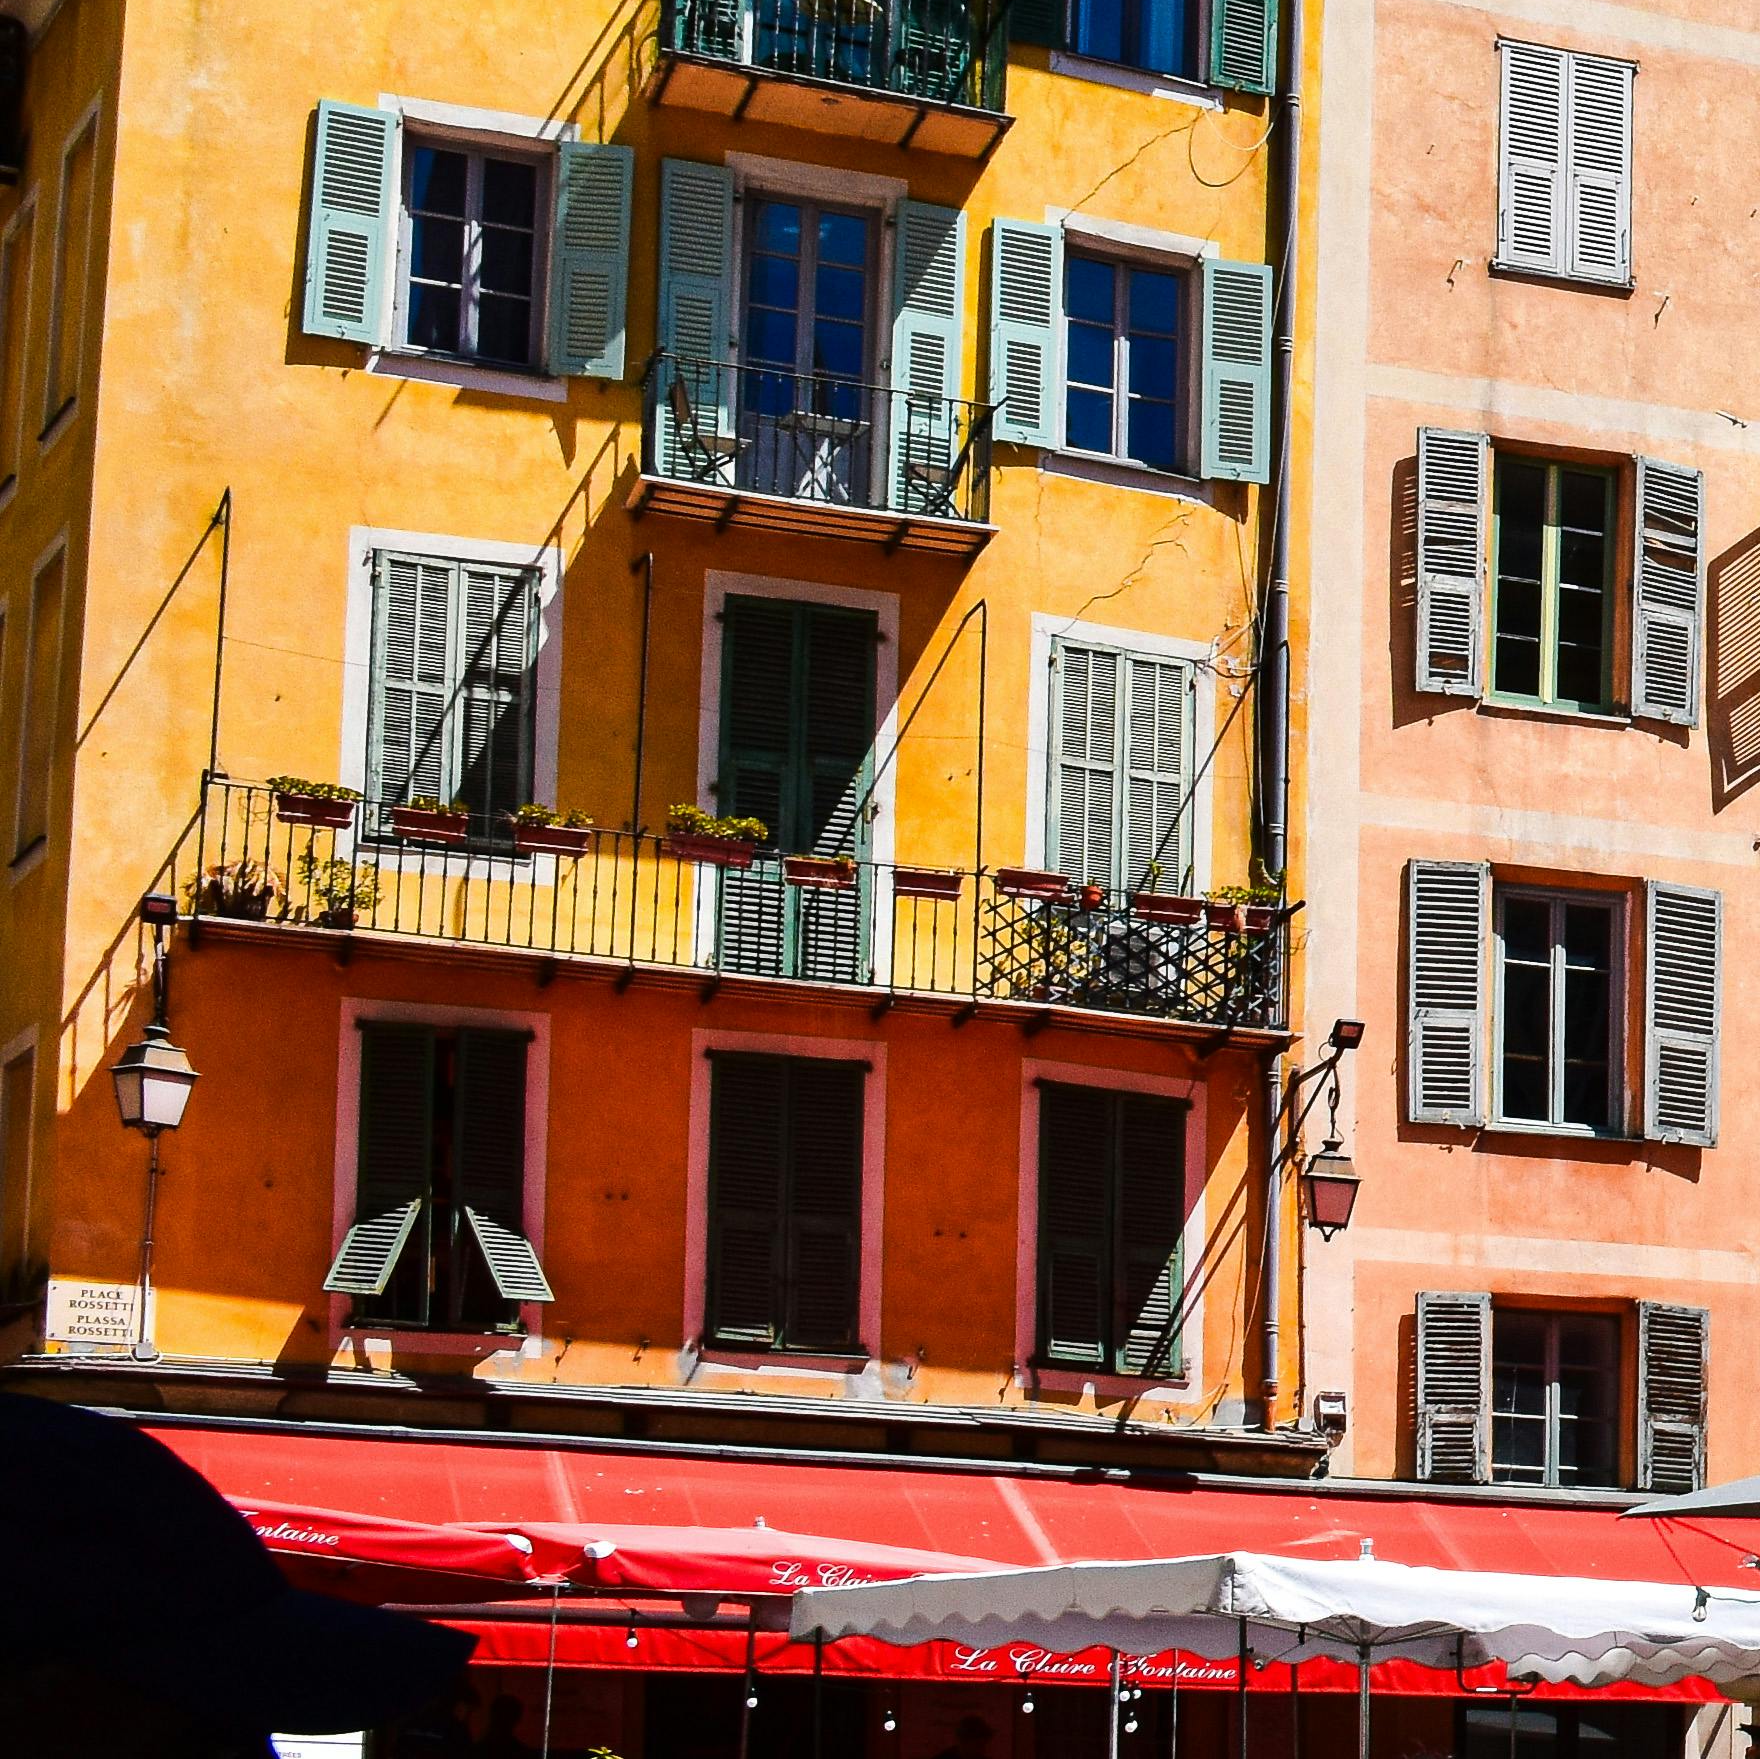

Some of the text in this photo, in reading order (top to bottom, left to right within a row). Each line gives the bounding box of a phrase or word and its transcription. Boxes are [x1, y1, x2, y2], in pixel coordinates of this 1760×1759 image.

[80, 1289, 124, 1300] PLACE
[69, 1300, 134, 1312] ROSSETTI
[77, 1315, 126, 1326] PLASSA
[68, 1326, 134, 1338] ROSSETTI
[769, 1561, 877, 1587] La Clai
[950, 1646, 1237, 1680] La Claire Fontaine
